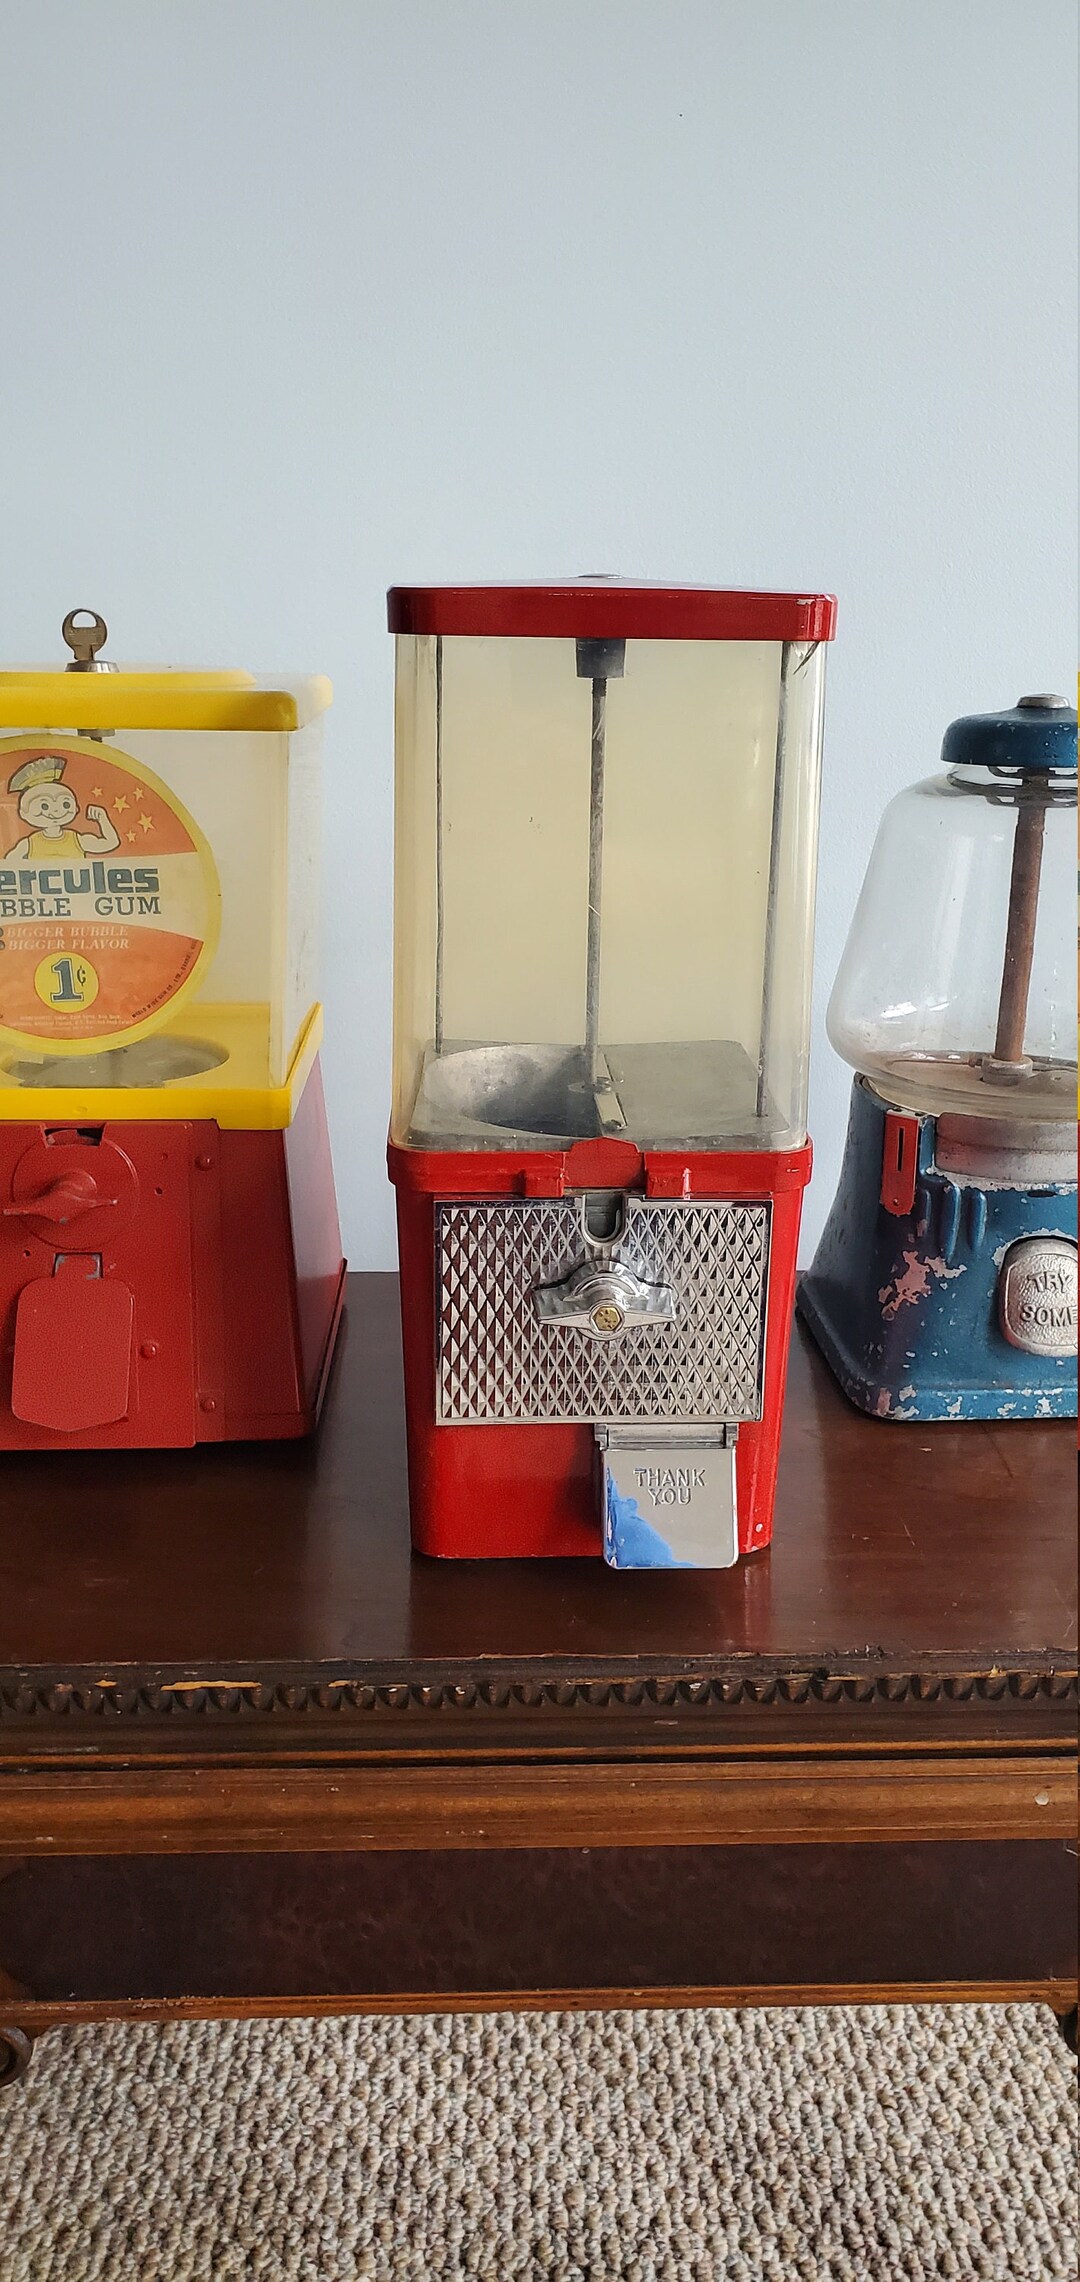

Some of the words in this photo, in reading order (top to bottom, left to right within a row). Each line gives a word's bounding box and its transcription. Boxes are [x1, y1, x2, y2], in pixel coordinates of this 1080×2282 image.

[95, 896, 162, 916] GUM
[7, 926, 65, 938] BIGGER
[70, 925, 129, 937] BUBBLE
[8, 938, 66, 950] BIGGER
[71, 938, 130, 950] FLAVOR
[1026, 1271, 1074, 1293] TRY
[1020, 1303, 1078, 1327] SOME
[633, 1467, 706, 1488] THANK
[648, 1488, 693, 1506] YOU
